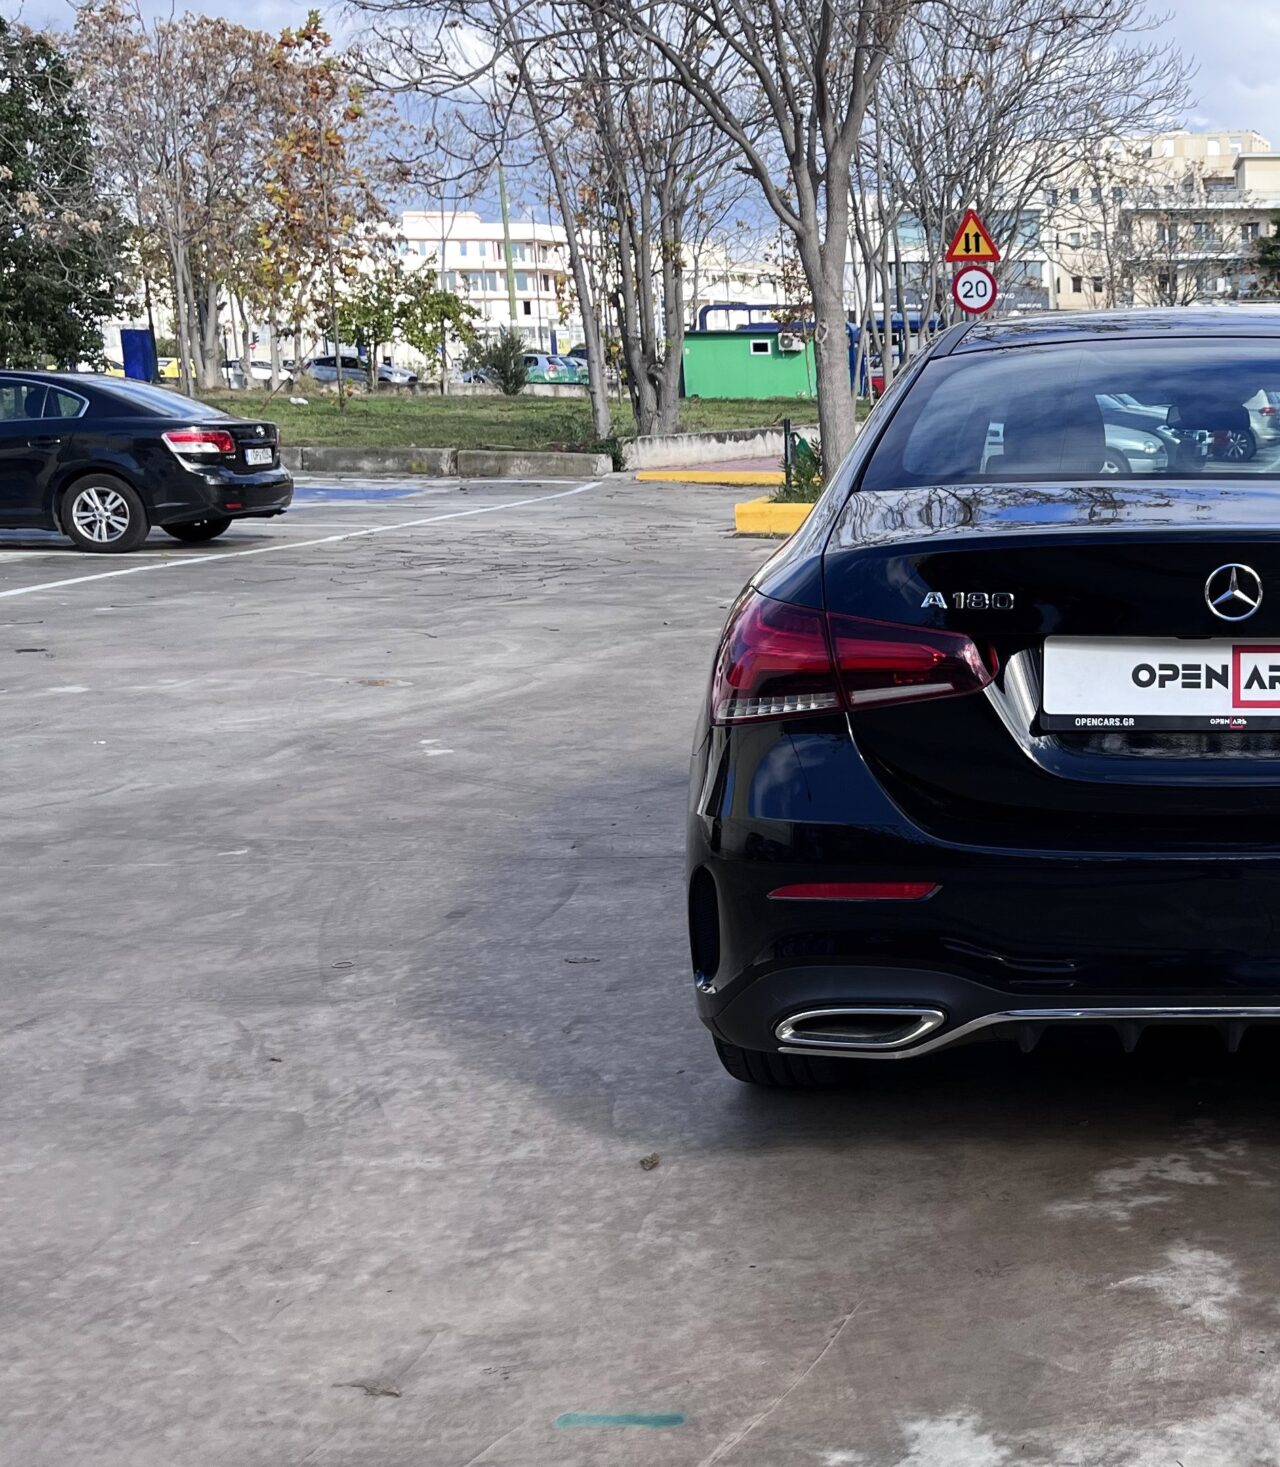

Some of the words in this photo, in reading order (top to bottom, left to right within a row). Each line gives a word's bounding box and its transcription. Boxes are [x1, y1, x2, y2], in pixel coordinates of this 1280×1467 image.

[962, 280, 988, 298] 20
[920, 592, 948, 609] A
[952, 592, 1015, 609] 180
[1075, 717, 1135, 726] OPENCARS.GR
